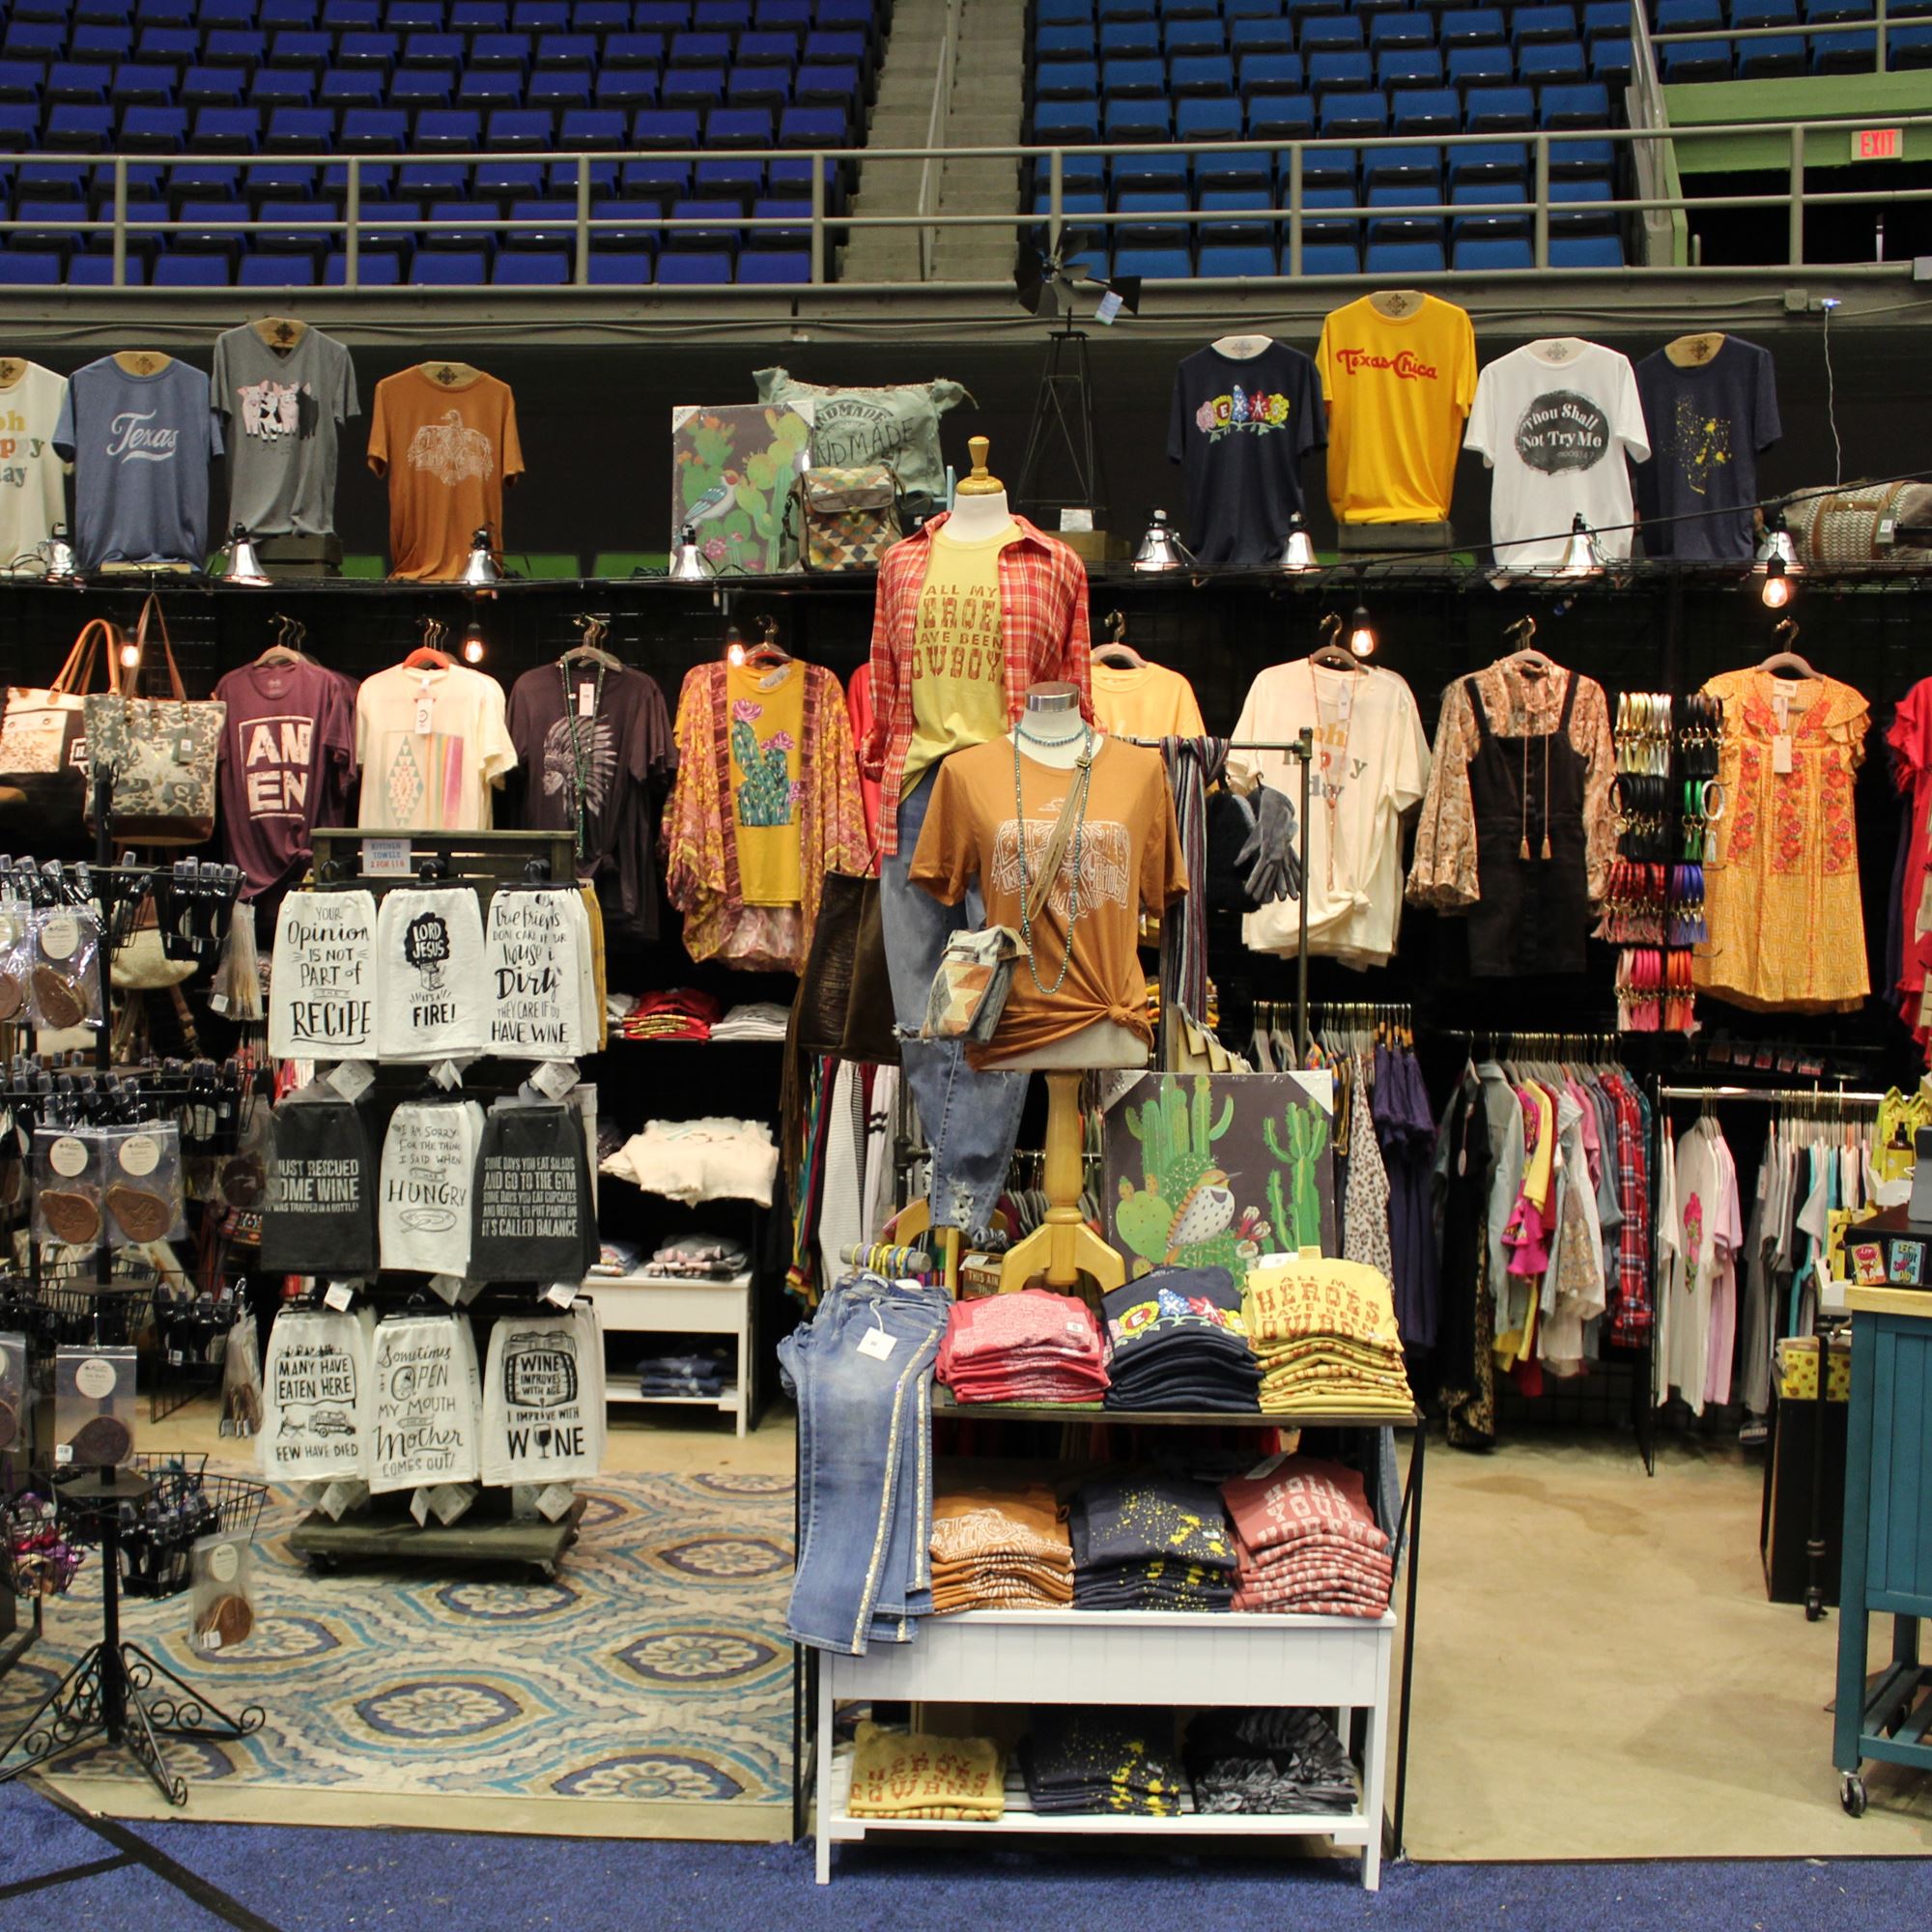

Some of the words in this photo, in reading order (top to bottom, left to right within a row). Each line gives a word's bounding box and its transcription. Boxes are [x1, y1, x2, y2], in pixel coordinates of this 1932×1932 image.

[1861, 128, 1896, 157] EXIT
[1336, 349, 1393, 375] Texas
[1392, 351, 1437, 381] Chica
[814, 404, 887, 431] NDMADE
[1521, 409, 1558, 431] Thou
[1561, 403, 1599, 431] Shall
[106, 410, 180, 462] Texas
[1520, 434, 1544, 451] Not
[1548, 431, 1577, 447] Try
[1577, 431, 1603, 447] Me
[0, 438, 45, 459] ppy
[0, 467, 27, 488] ay
[925, 584, 959, 595] ALL
[970, 585, 998, 598] MY
[922, 597, 1003, 632] EROE
[918, 632, 951, 644] AVE
[959, 633, 1004, 650] BEEN
[912, 645, 1002, 681] OWBOY
[315, 907, 342, 921] YOUR
[287, 921, 369, 950] Opinion
[412, 922, 441, 942] LORD
[309, 949, 321, 962] IS
[326, 948, 354, 961] NOT
[412, 940, 444, 958] JESUS
[300, 962, 340, 987] PART
[345, 961, 362, 984] of
[495, 966, 558, 1003] Dirty
[289, 1001, 371, 1037] RECIPE
[412, 1004, 456, 1027] FIRE!
[517, 1001, 538, 1019] CARE
[491, 1020, 526, 1042] HAVE
[531, 1022, 570, 1043] WINE
[307, 1158, 359, 1177] RESCUED
[503, 1156, 521, 1171] DAYS
[317, 1178, 360, 1201] WINE
[484, 1172, 502, 1190] AND
[504, 1172, 518, 1190] GO
[521, 1172, 533, 1190] TO
[534, 1172, 553, 1190] THE
[554, 1172, 577, 1190] GYM
[387, 1179, 467, 1207] HUNGRY
[498, 1219, 534, 1236] CALLED
[536, 1219, 578, 1236] BALANCE
[986, 1274, 999, 1287] AIN
[1256, 1282, 1379, 1325] HEROES
[378, 1345, 451, 1368] Sometimes
[521, 1355, 559, 1372] WINE
[278, 1360, 315, 1377] MANY
[321, 1358, 349, 1374] HAVE
[279, 1379, 316, 1399] EATEN
[321, 1377, 352, 1397] HERE
[520, 1373, 561, 1386] IMPROVES
[523, 1386, 544, 1396] WITH
[378, 1404, 400, 1419] MY
[407, 1396, 456, 1416] MOUTH
[558, 1406, 580, 1420] WITH
[276, 1446, 300, 1462] FEW
[304, 1444, 329, 1458] HAVE
[333, 1443, 358, 1457] DIED
[372, 1425, 464, 1462] Mother
[383, 1458, 422, 1477] COMES
